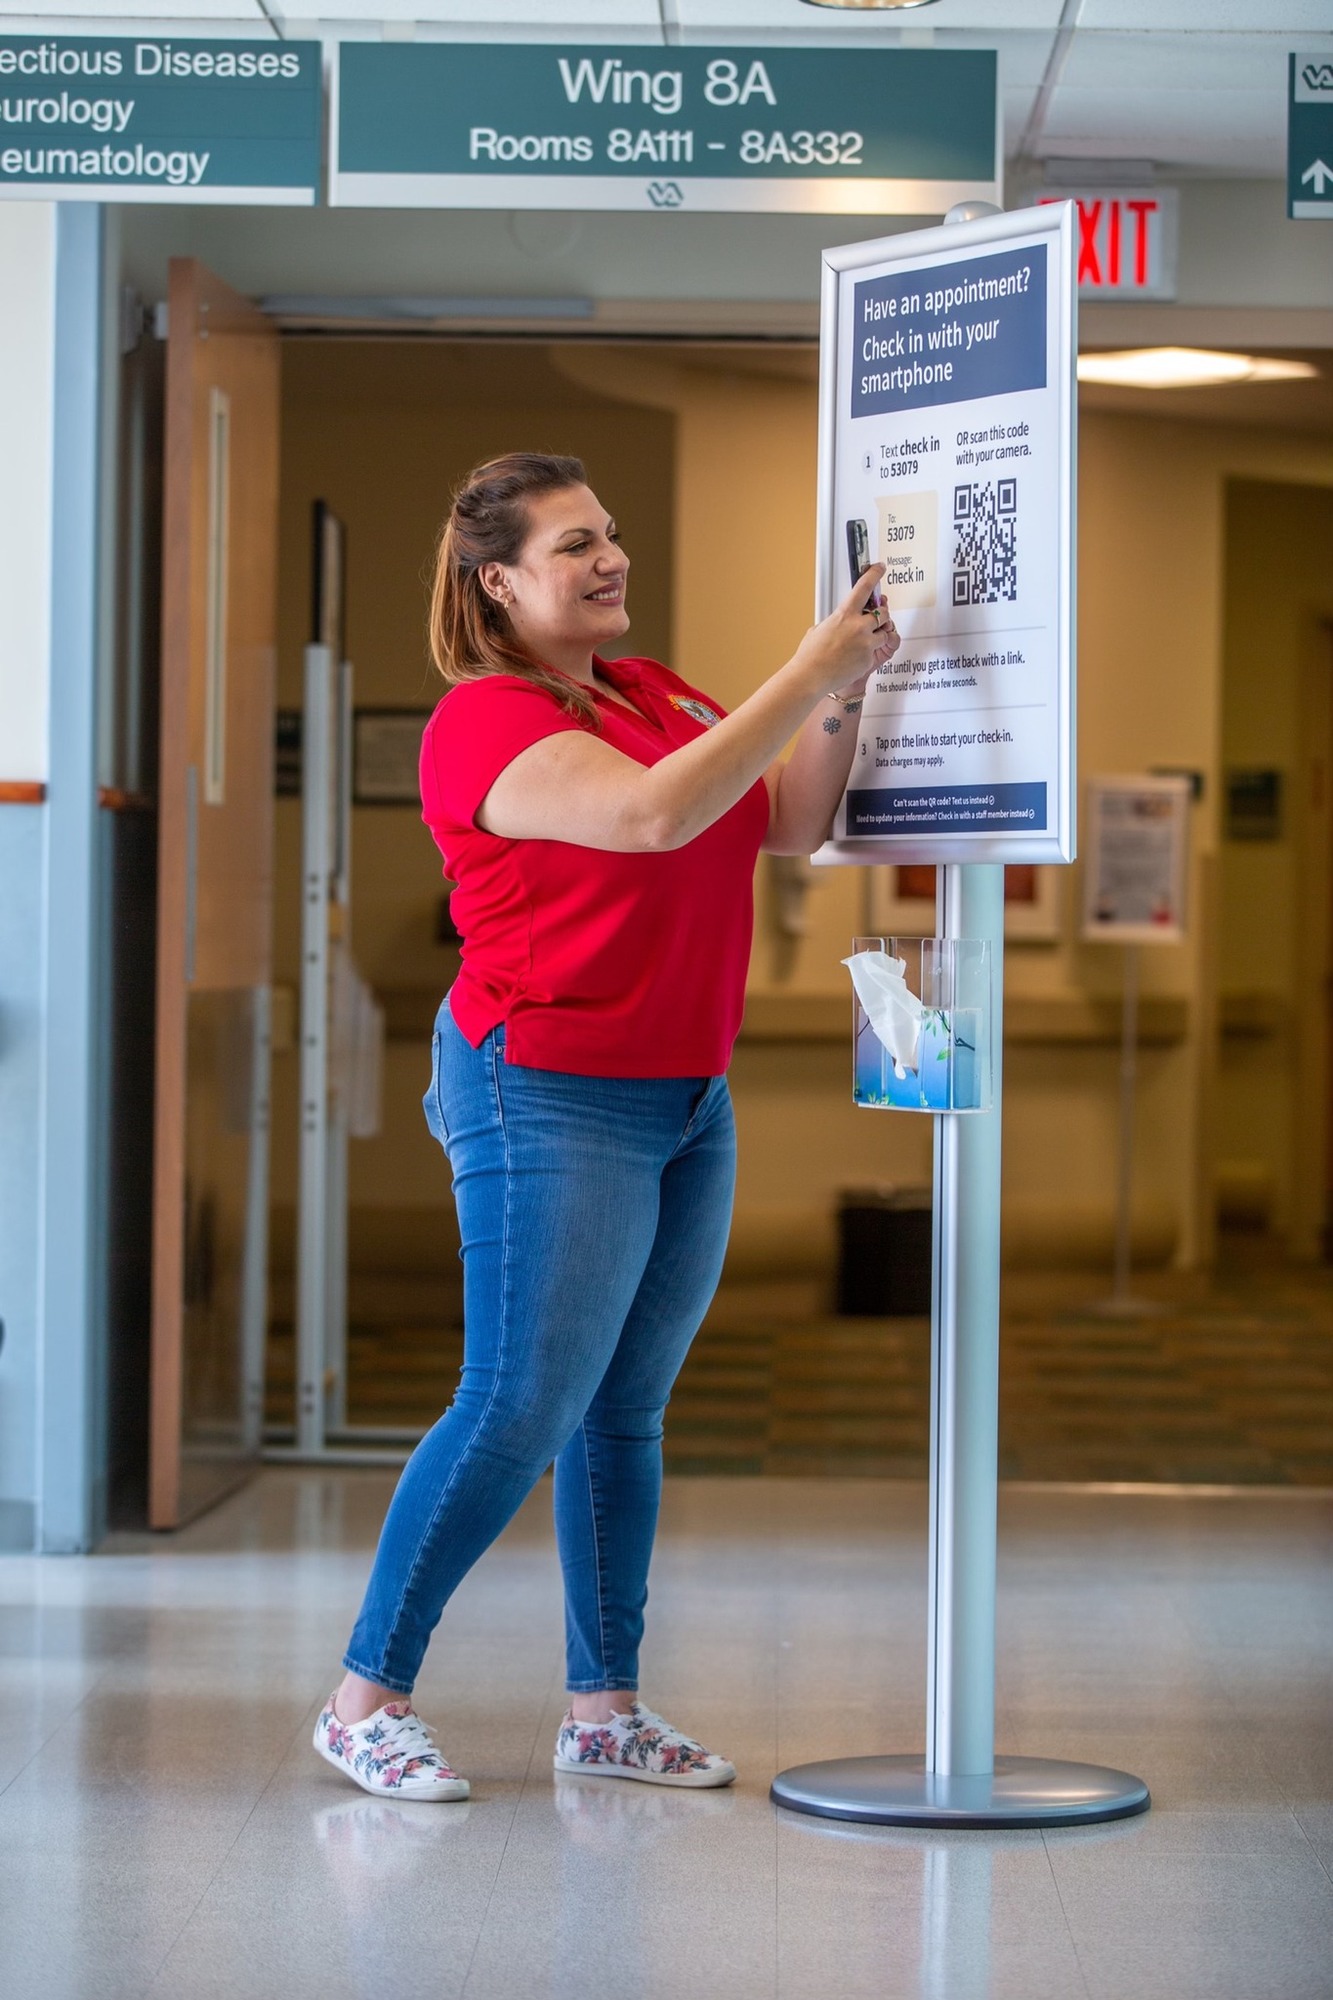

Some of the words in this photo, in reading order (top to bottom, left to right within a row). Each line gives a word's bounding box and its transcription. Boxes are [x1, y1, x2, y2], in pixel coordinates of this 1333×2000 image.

[0, 43, 123, 76] ectious
[135, 44, 301, 79] Diseases
[558, 58, 683, 115] Wing
[704, 59, 777, 107] 8A
[0, 91, 134, 133] urology
[469, 127, 594, 162] Rooms
[607, 128, 694, 163] 8A111
[706, 141, 727, 151] -
[739, 131, 863, 165] 8A332
[1, 144, 210, 185] eumatology
[1040, 199, 1157, 287] XIT
[864, 298, 897, 323] Have
[901, 294, 920, 316] an
[924, 266, 1031, 316] appointment?
[862, 331, 905, 362] Check
[909, 328, 923, 353] in
[928, 320, 962, 350] with
[966, 319, 1000, 350] your
[861, 361, 953, 394] smartphone
[956, 431, 969, 447] OR
[970, 431, 988, 445] scan
[989, 425, 1006, 441] this
[1007, 421, 1029, 438] code
[880, 444, 899, 459] Text
[899, 437, 928, 456] check
[930, 436, 940, 452] in
[956, 449, 974, 465] with
[975, 448, 994, 467] your
[995, 444, 1032, 460] camera.
[866, 455, 871, 468] 1
[880, 466, 889, 479] to
[890, 460, 919, 477] 53079
[888, 513, 897, 524] To:
[887, 525, 915, 542] 53079
[887, 556, 912, 567] Message:
[887, 567, 914, 585] check
[915, 566, 924, 582] in
[894, 659, 911, 674] until
[912, 661, 927, 676] you
[928, 658, 940, 675] get
[941, 660, 946, 670] a
[946, 657, 961, 670] text
[962, 653, 980, 669] back
[981, 652, 999, 667] with
[1000, 655, 1006, 665] a
[1007, 650, 1026, 665] link.
[876, 683, 888, 693] This
[888, 681, 908, 692] should
[909, 680, 922, 693] only
[923, 678, 936, 690] take
[941, 678, 951, 689] few
[952, 676, 978, 688] seconds.
[861, 743, 867, 756] 3
[876, 737, 889, 751] Tap
[890, 737, 901, 749] on
[901, 734, 915, 748] the
[915, 733, 930, 748] link
[931, 735, 939, 747] to
[940, 733, 957, 746] start
[958, 733, 976, 748] your
[977, 729, 1014, 743] check-in.
[875, 757, 889, 767] Data
[890, 756, 913, 768] charges
[914, 758, 926, 768] may
[927, 754, 945, 767] apply.
[893, 798, 908, 807] Can't
[908, 799, 919, 807] scan
[920, 797, 928, 807] the
[928, 797, 936, 807] QR
[937, 796, 951, 806] code?
[952, 796, 962, 805] Text
[969, 795, 988, 805] instead
[869, 814, 875, 823] to
[876, 813, 893, 824] update
[893, 814, 905, 824] your
[938, 811, 953, 820] Check
[954, 811, 959, 820] in
[960, 810, 971, 819] with
[976, 810, 987, 819] staff
[988, 809, 1009, 819] member
[1009, 808, 1029, 818] instead
